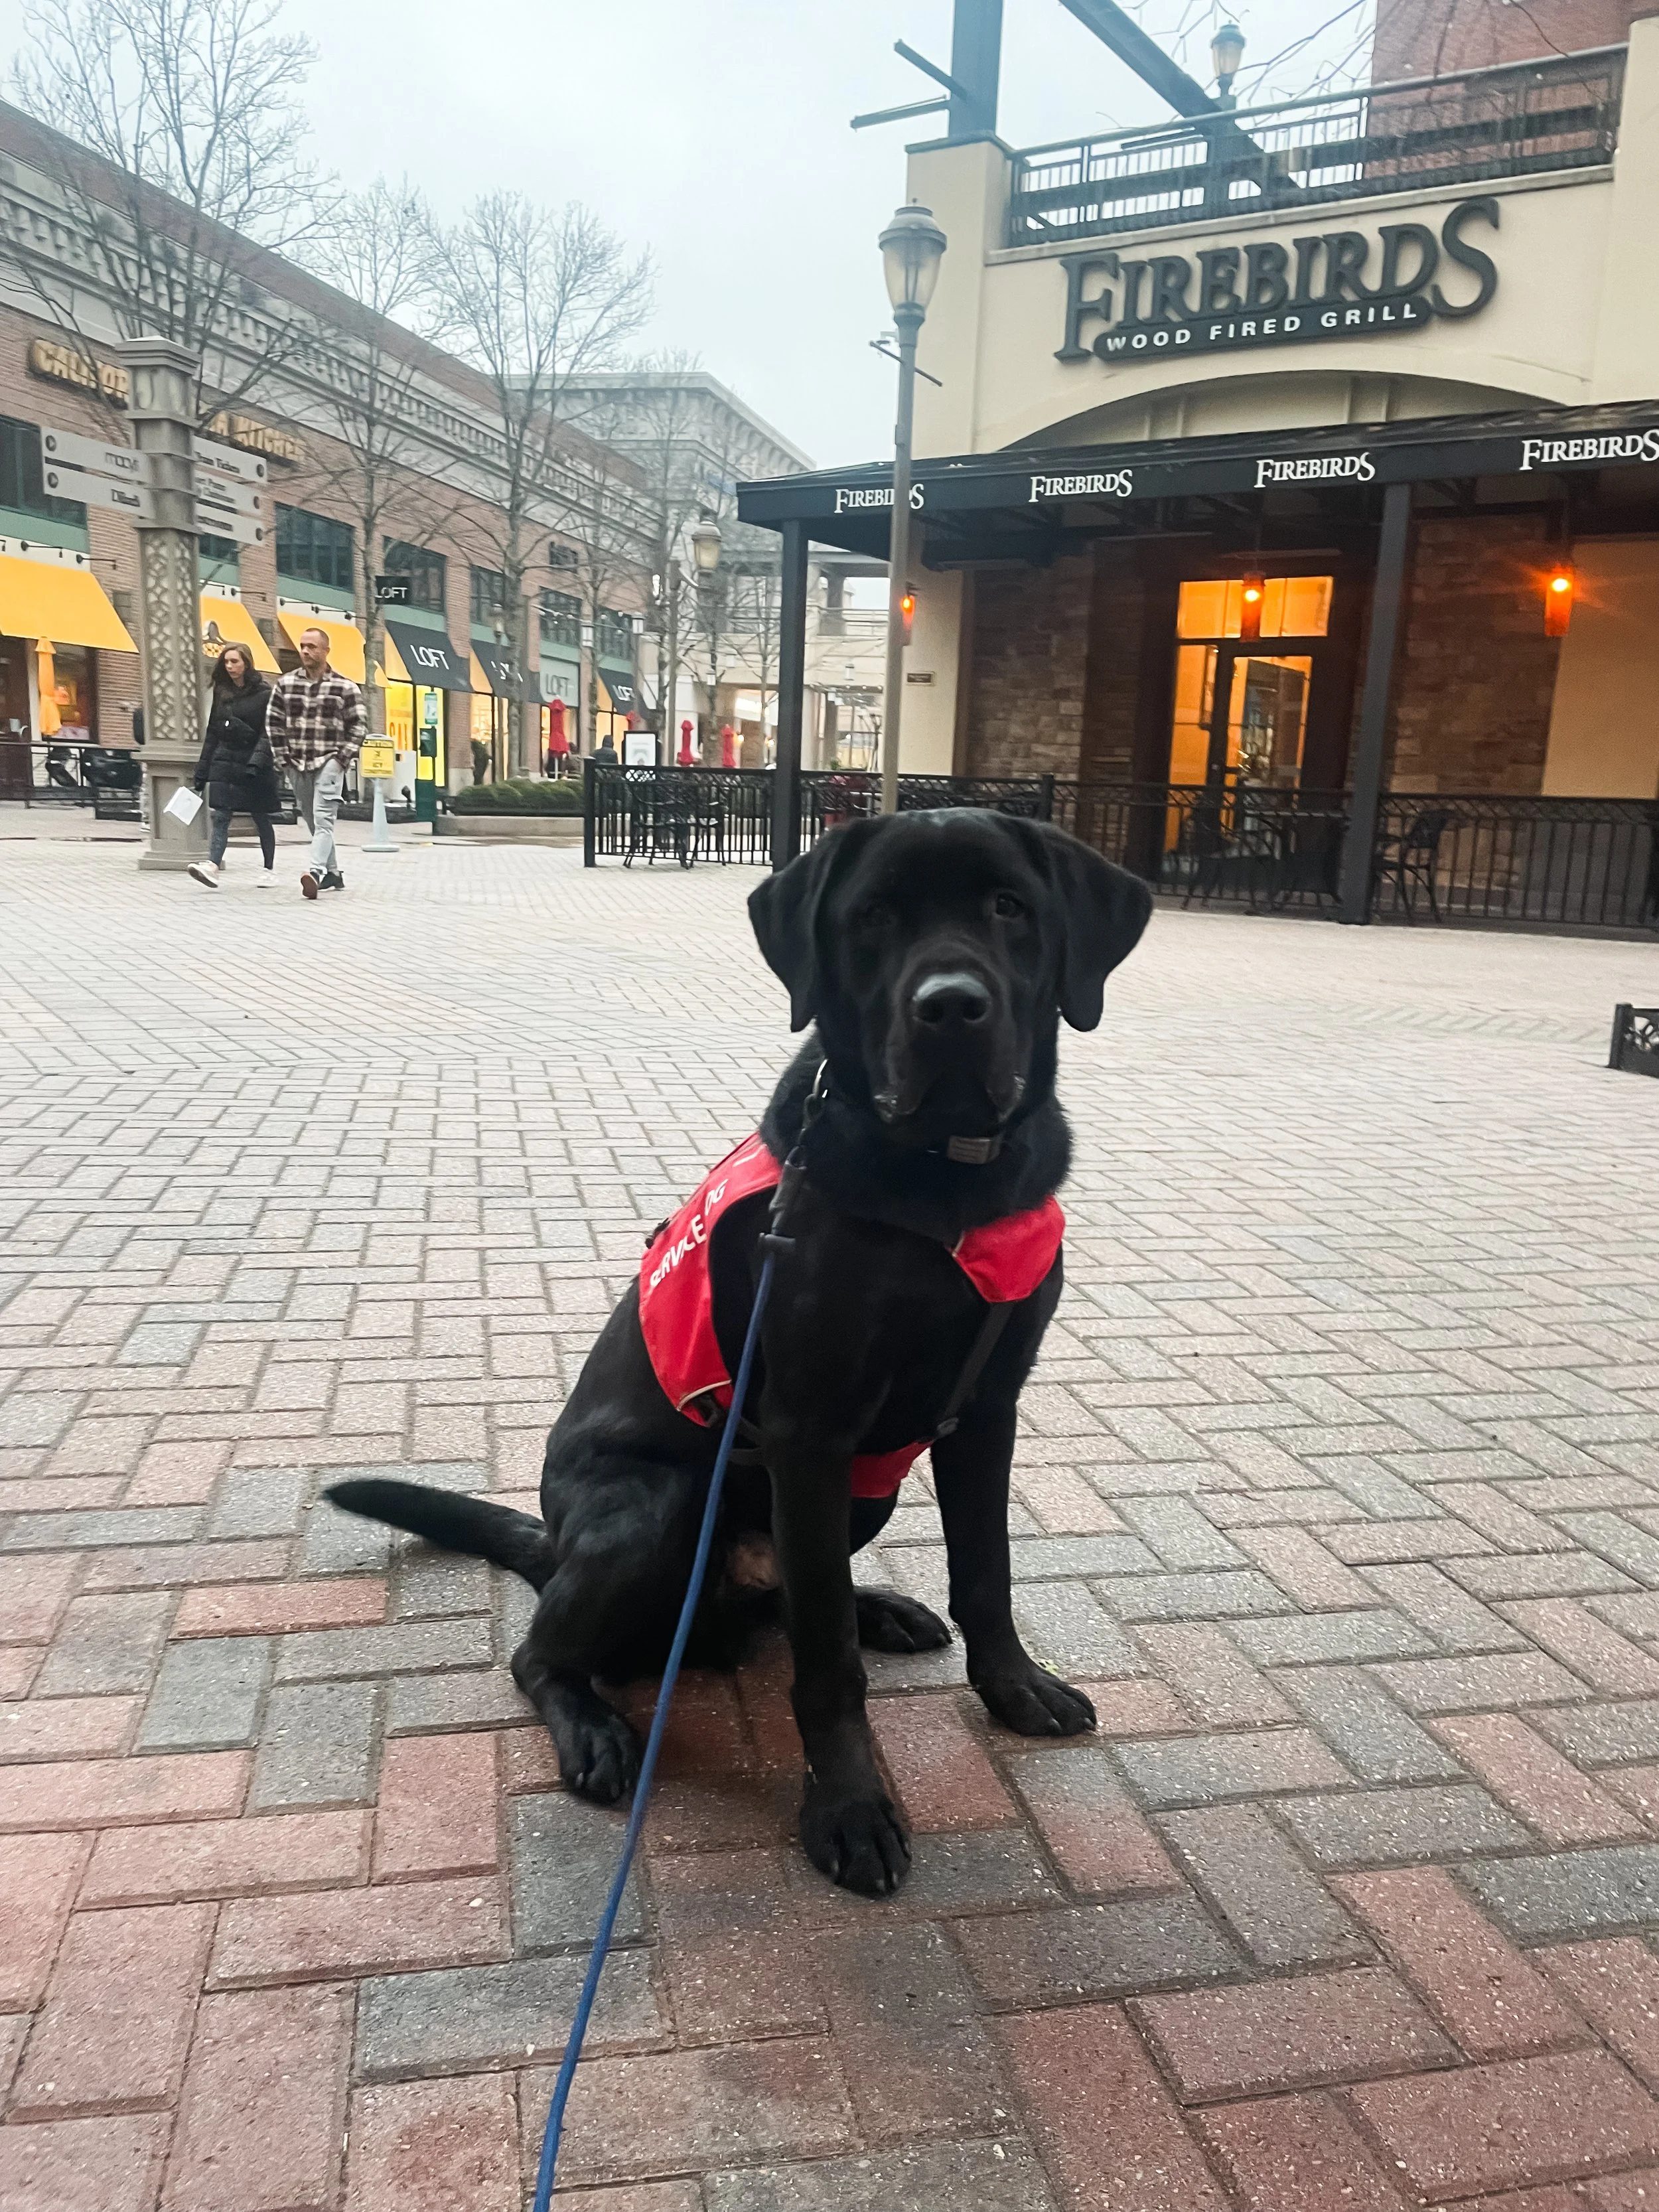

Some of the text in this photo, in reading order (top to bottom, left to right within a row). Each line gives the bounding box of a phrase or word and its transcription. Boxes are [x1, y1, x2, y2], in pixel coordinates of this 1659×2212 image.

[1054, 197, 1500, 364] FIREBIRDS
[1106, 303, 1417, 352] WOOD FIRED GRILL
[1519, 429, 1659, 471] FIREBIRDS
[1029, 469, 1133, 503] FIREBIRDS
[1254, 452, 1376, 488] FIREBIRDS
[833, 483, 924, 514] FIREBIS
[410, 644, 449, 670] LOFT
[546, 674, 569, 697] LOFT
